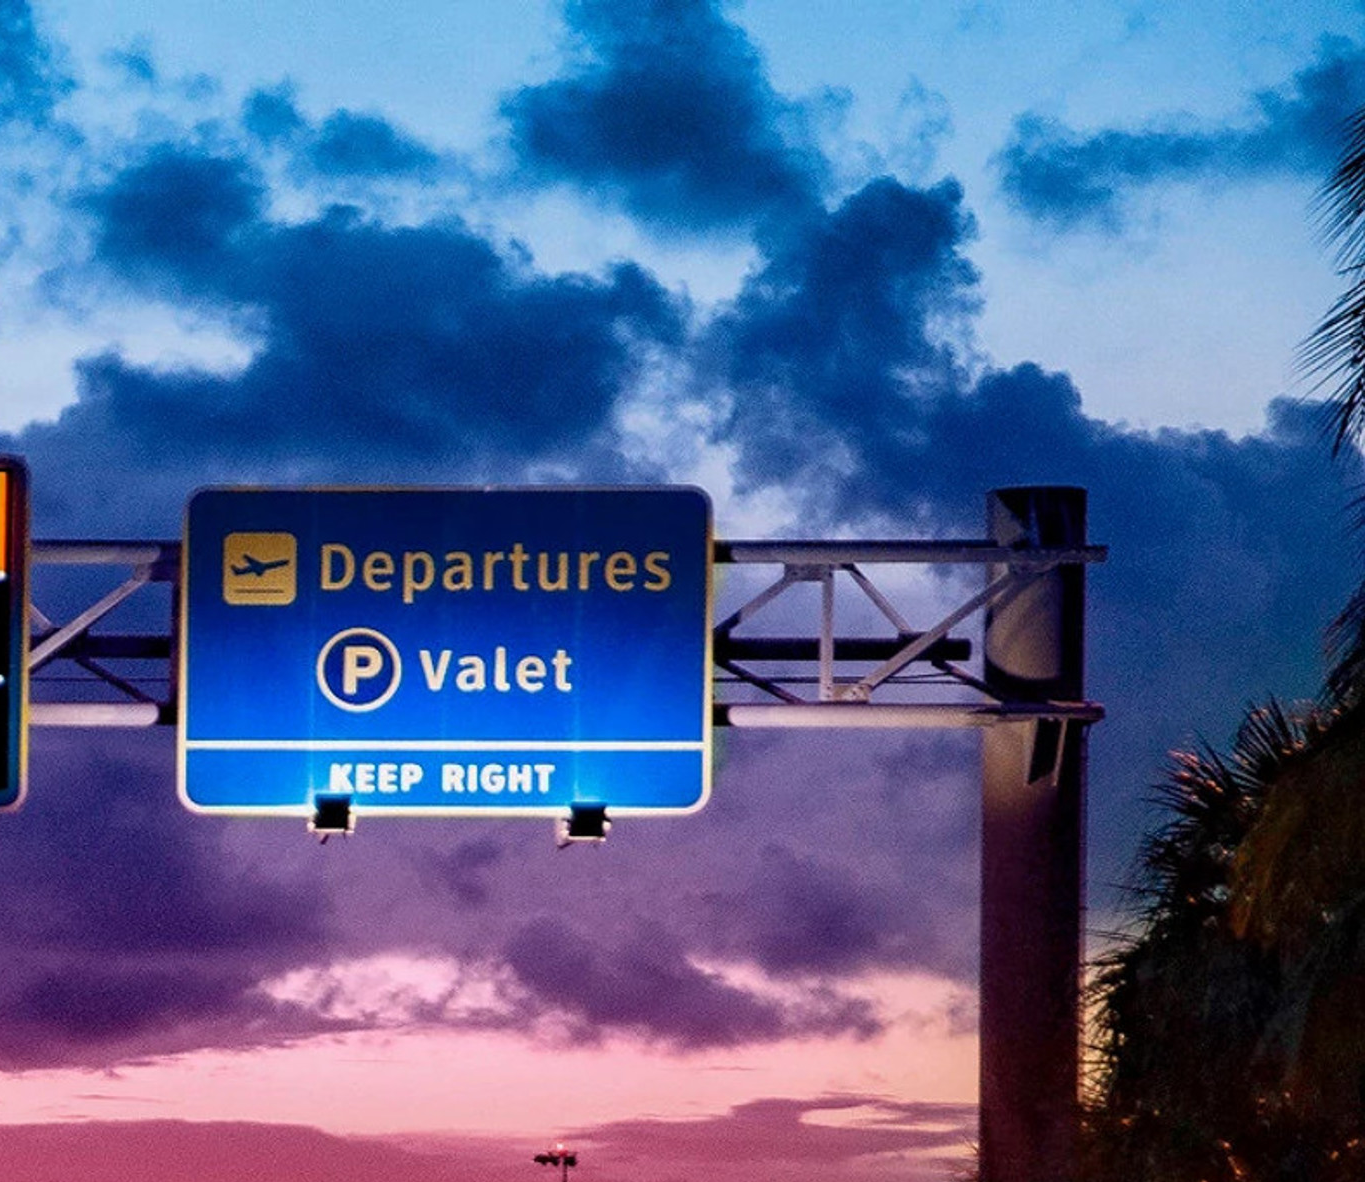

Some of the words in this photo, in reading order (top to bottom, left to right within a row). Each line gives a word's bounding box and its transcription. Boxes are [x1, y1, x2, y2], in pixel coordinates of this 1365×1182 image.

[320, 543, 671, 603] Departures
[419, 646, 572, 693] Valet
[329, 763, 423, 794] KEEP
[441, 764, 556, 794] RIGHT
